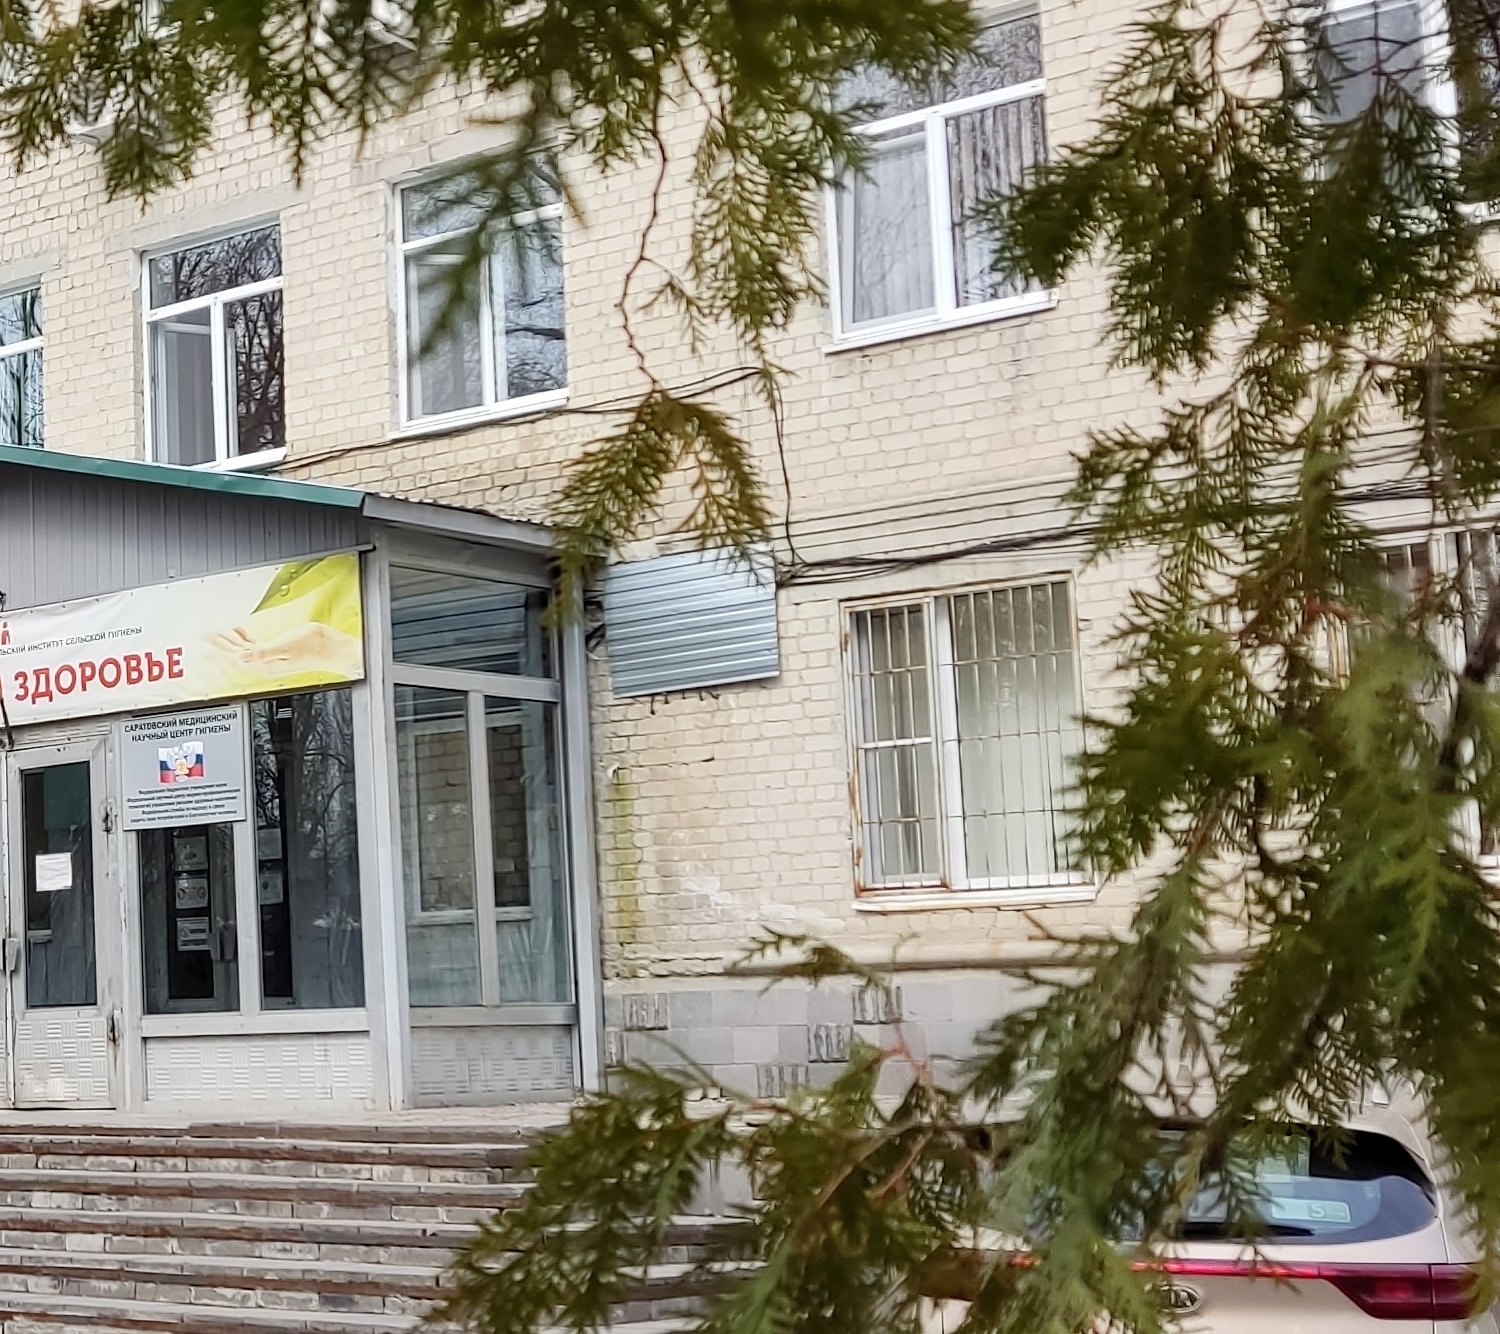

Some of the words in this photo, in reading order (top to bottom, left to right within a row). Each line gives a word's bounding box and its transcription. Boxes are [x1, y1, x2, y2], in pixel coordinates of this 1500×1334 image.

[27, 639, 63, 652] ИНСТИТУТ
[65, 631, 106, 646] СЕЛЬСКОЙ
[107, 626, 142, 639] ГИГИЕНЫ
[14, 647, 184, 705] ЗДОРОВЬЕ
[124, 717, 177, 733] САРАТОВСКИЙ
[178, 710, 238, 726] МЕДИЦИНСКИЙ
[131, 729, 169, 742] НАУЧНЫЙ
[169, 727, 194, 739] ЦЕНТР
[195, 724, 231, 735] ГИГИЕНЫ
